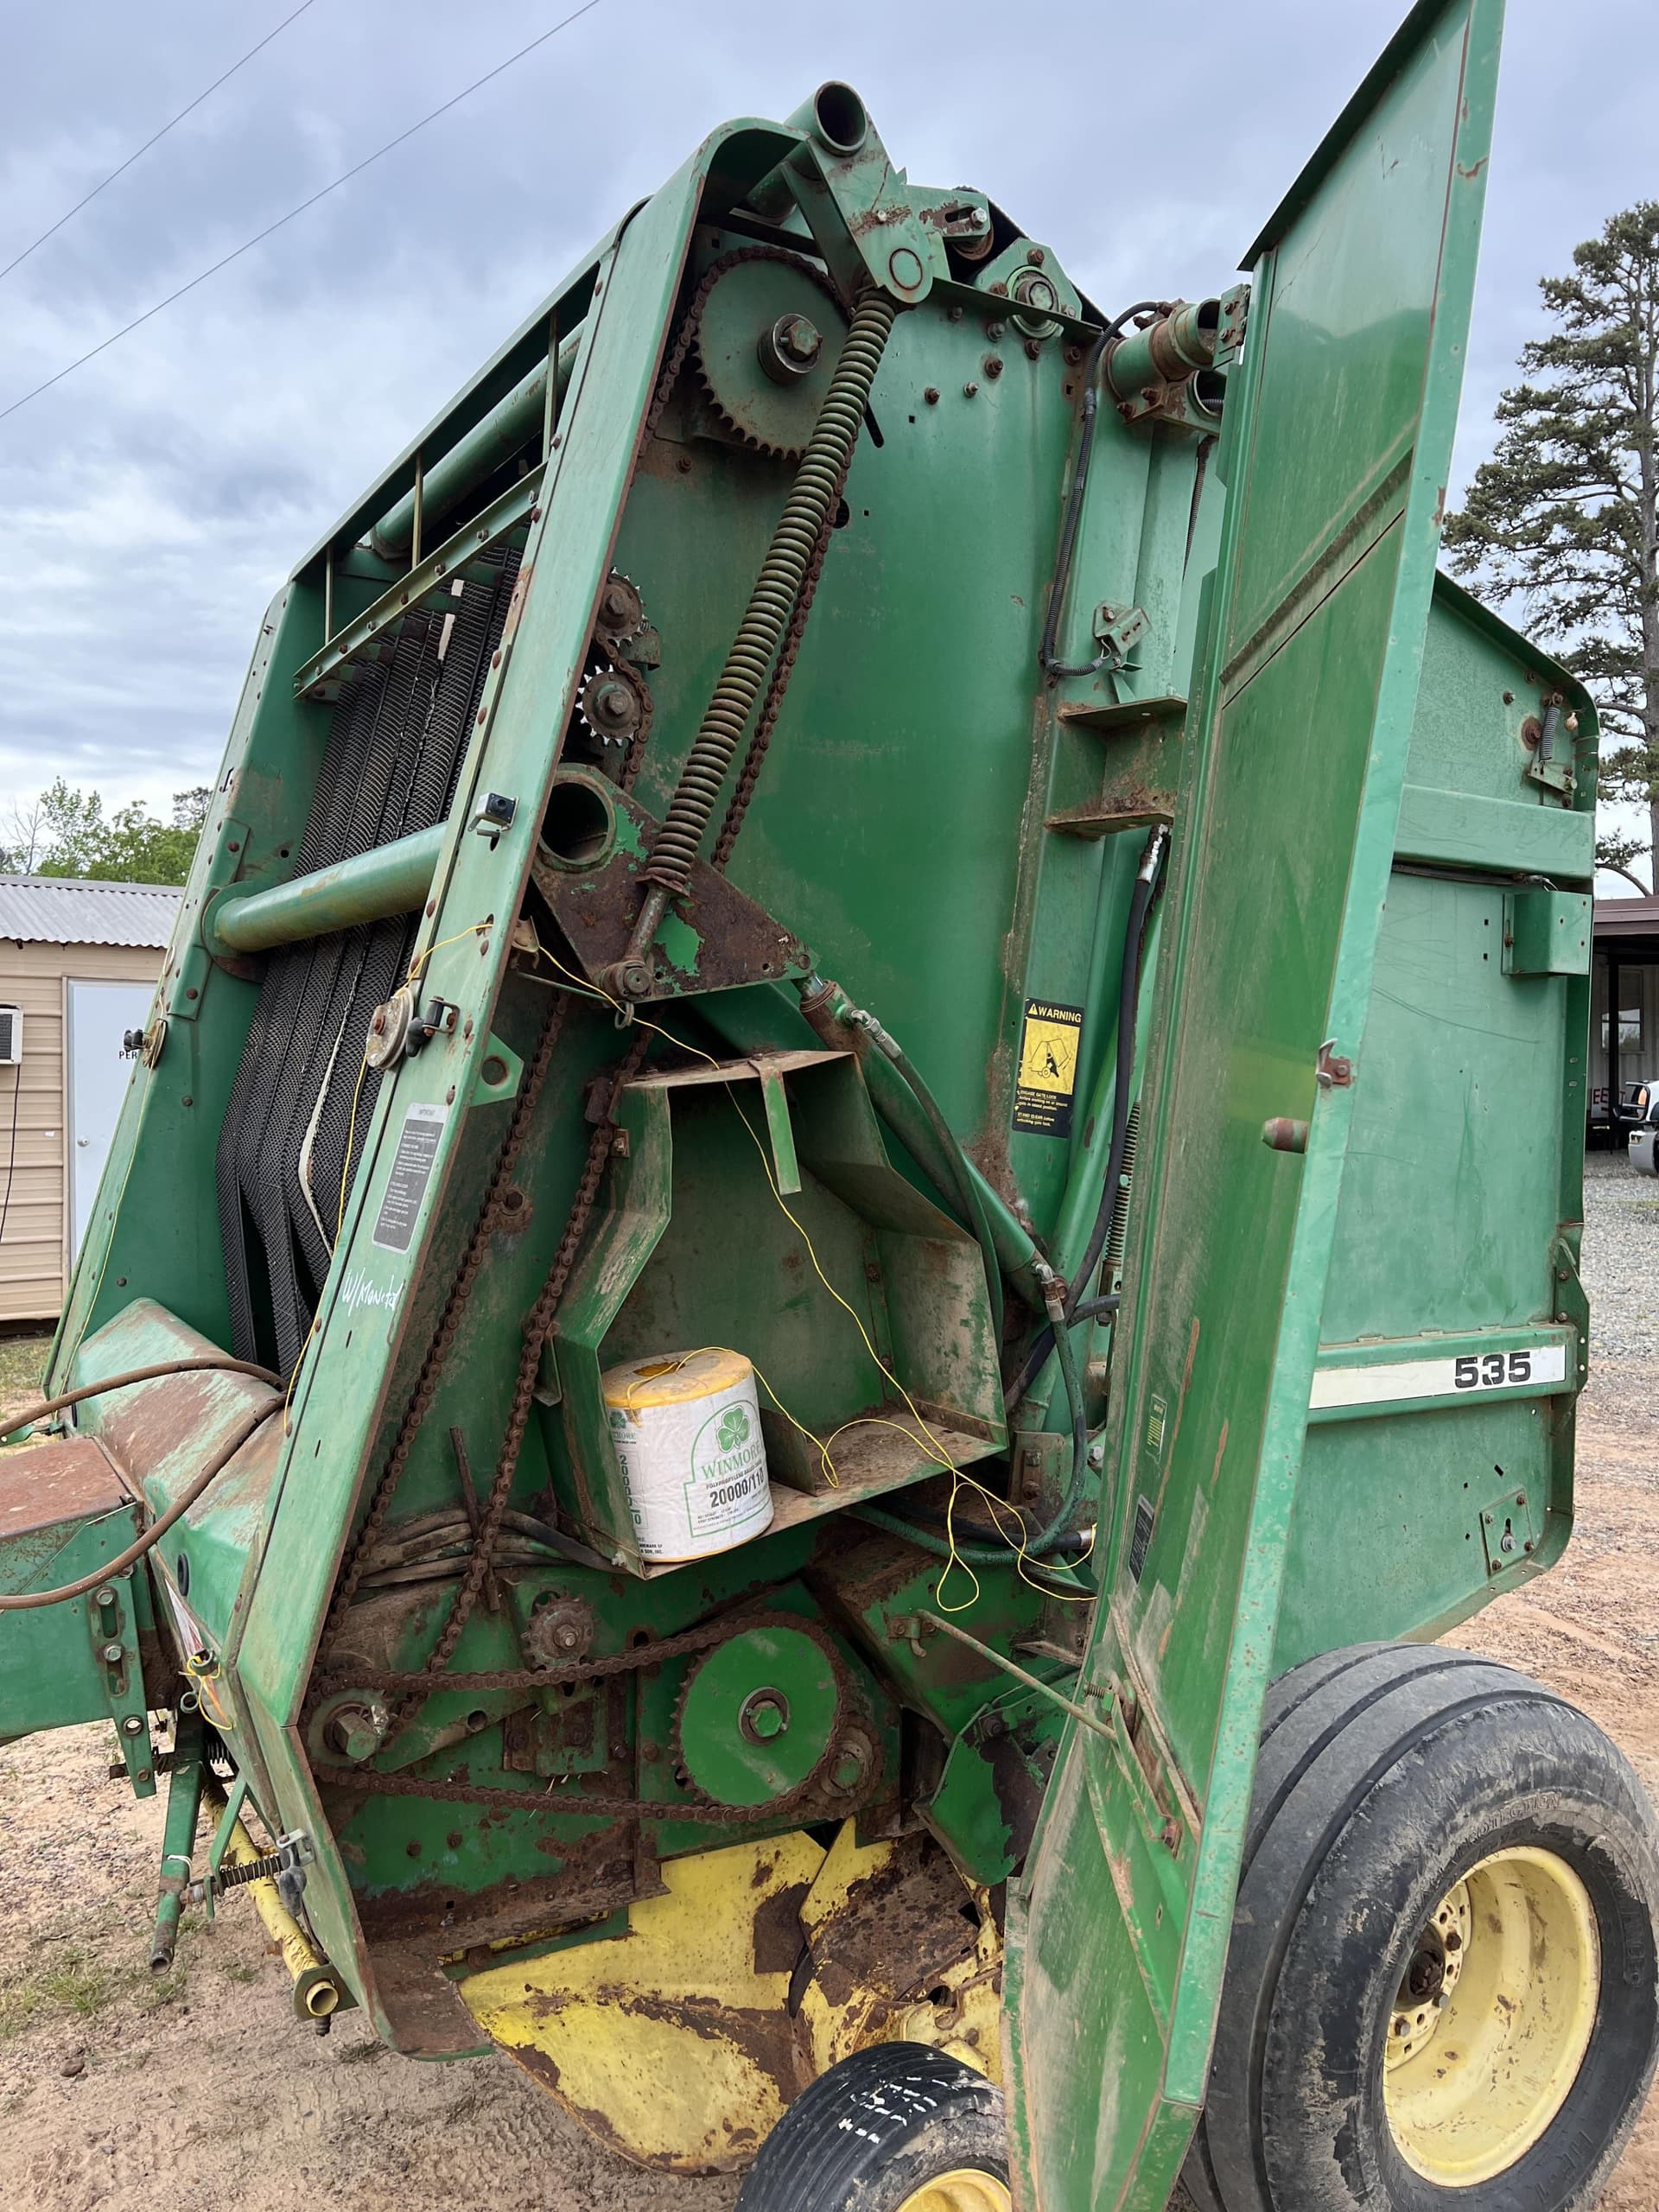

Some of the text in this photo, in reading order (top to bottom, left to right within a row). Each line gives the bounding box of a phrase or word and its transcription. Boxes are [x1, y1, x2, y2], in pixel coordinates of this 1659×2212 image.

[1039, 1006, 1082, 1023] WARNING
[1454, 1351, 1531, 1389] 535
[709, 1466, 764, 1508] 20000/110
